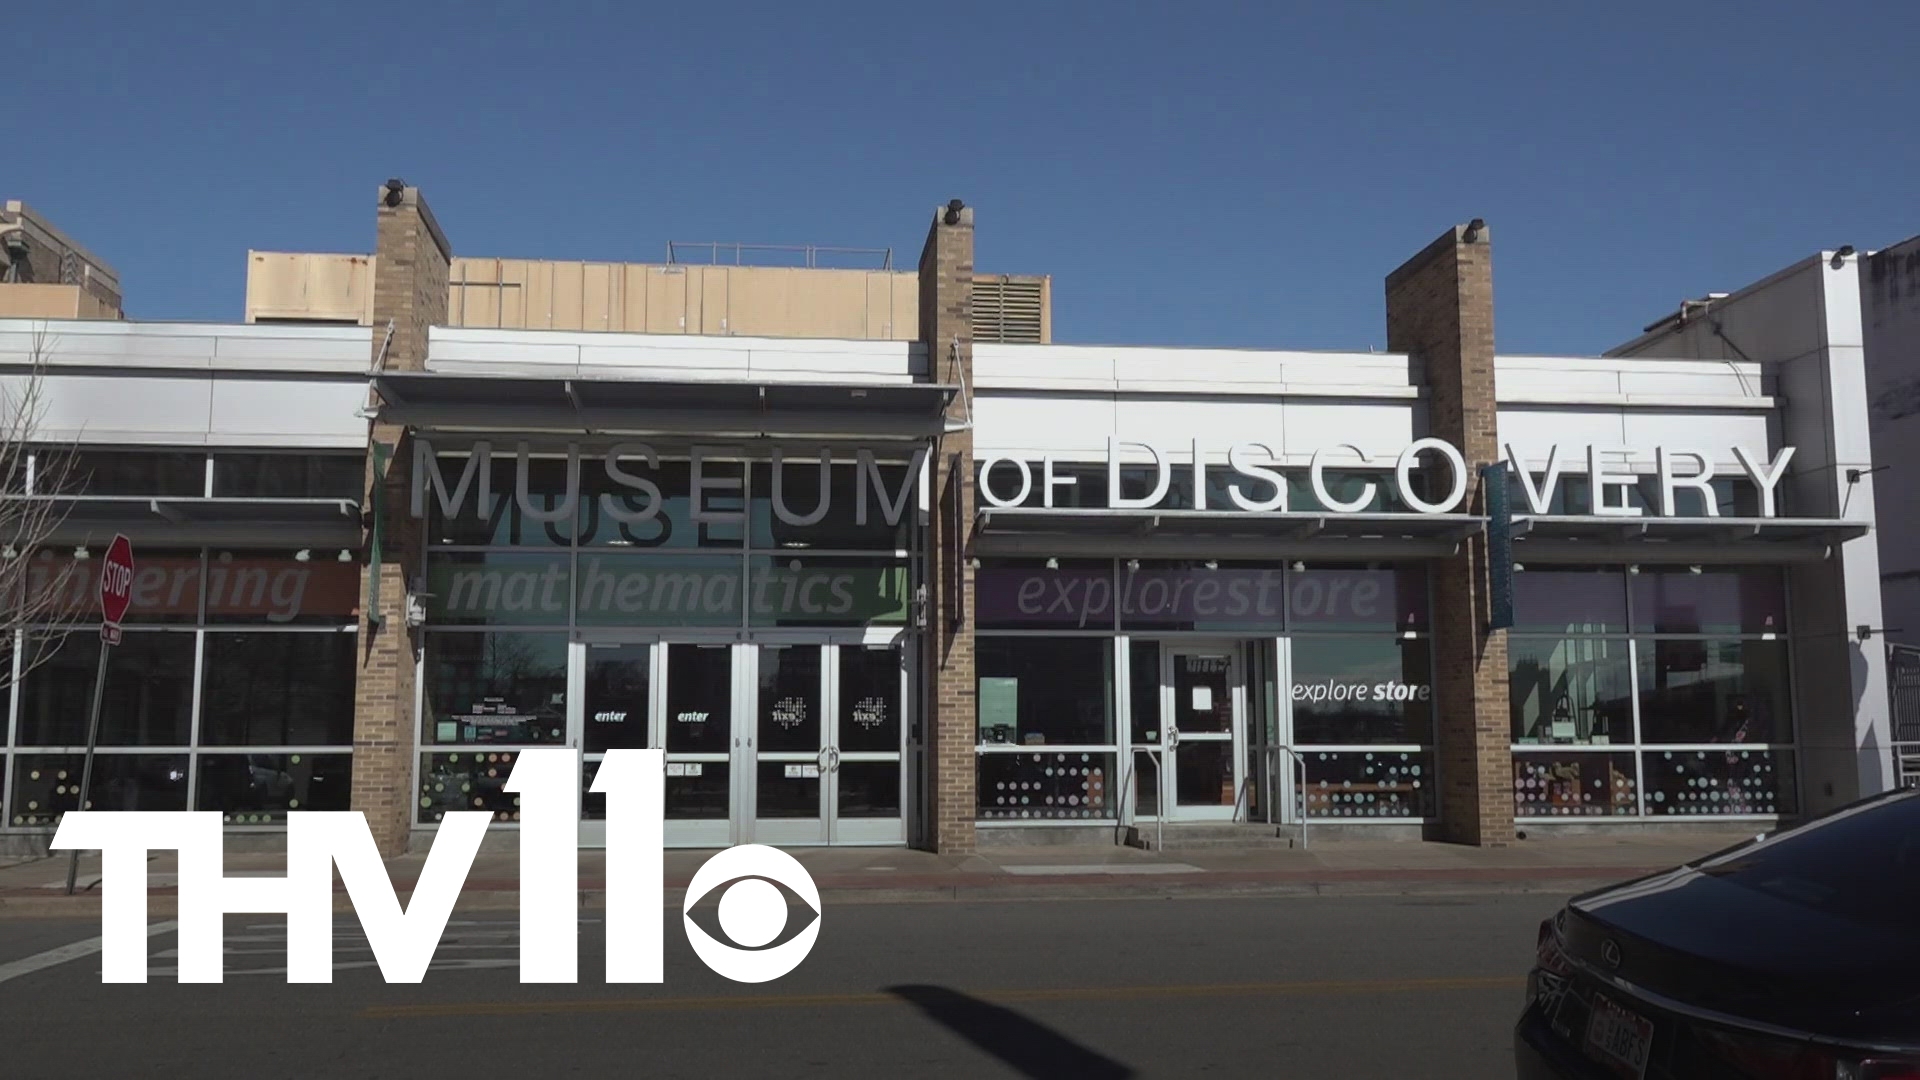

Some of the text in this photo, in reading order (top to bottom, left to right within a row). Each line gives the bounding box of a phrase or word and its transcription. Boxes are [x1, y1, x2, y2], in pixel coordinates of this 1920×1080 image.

[410, 435, 1797, 527] MUSEUM OF DISCOVERY
[104, 560, 131, 598] STOP
[1291, 678, 1431, 704] explore store
[594, 710, 627, 722] enter
[677, 710, 709, 722] enter
